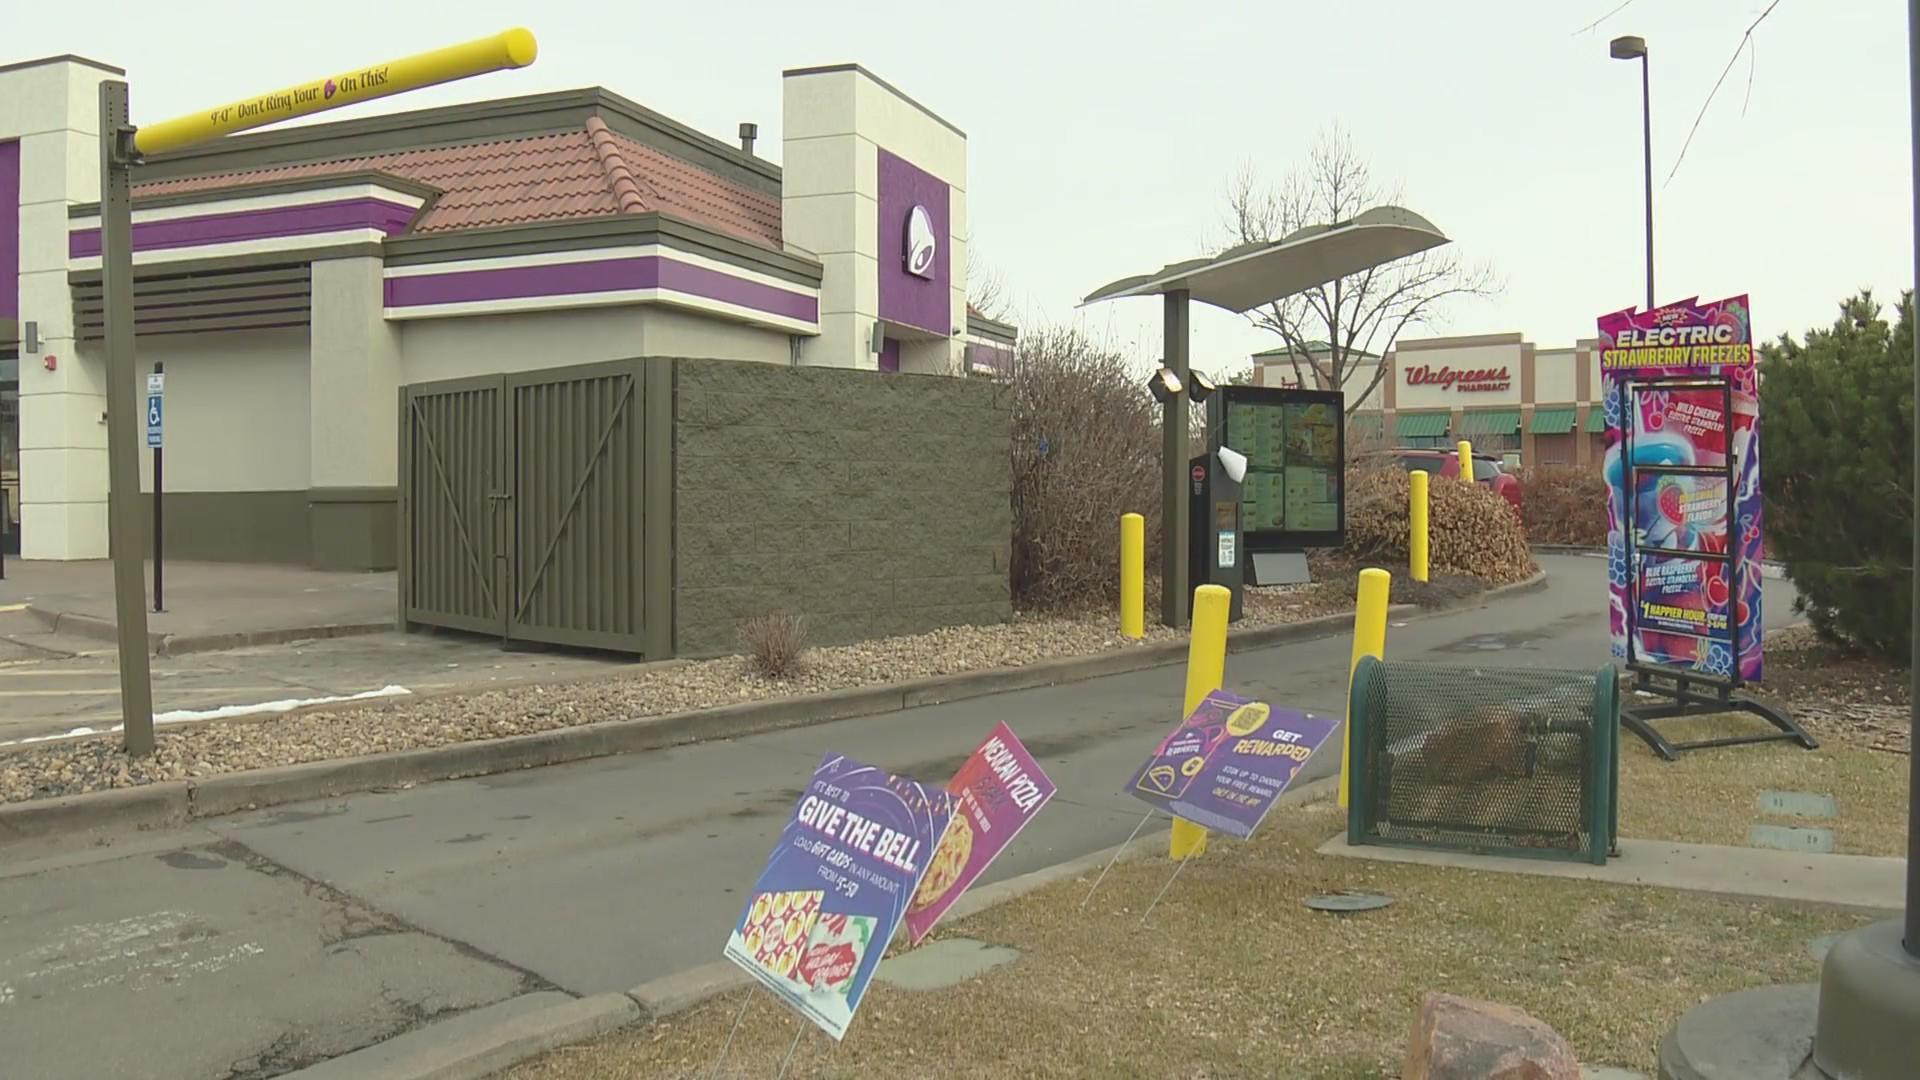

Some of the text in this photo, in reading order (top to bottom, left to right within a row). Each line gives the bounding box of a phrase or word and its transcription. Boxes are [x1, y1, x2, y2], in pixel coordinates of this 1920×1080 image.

[238, 100, 265, 119] Don't
[294, 87, 320, 105] Your
[340, 77, 357, 93] On
[360, 67, 389, 88] This!
[1616, 324, 1733, 348] ELECTRIC
[1603, 344, 1751, 368] STRAWBERRY FREEZES
[1405, 365, 1511, 391] Walgreens
[1457, 382, 1511, 392] PHARMACY
[1650, 604, 1682, 619] HAPPIER
[1272, 729, 1303, 743] GET
[1233, 739, 1313, 762] REWARDED
[978, 736, 1022, 783] MEXICAN
[1006, 773, 1043, 814] PIZZA
[813, 780, 827, 793] IT'S
[824, 784, 842, 799] BEST
[798, 795, 846, 836] GIVE
[839, 811, 881, 852] THE
[793, 835, 813, 851] LOAD
[811, 840, 831, 858] GIFT
[826, 849, 853, 869] CARDS
[867, 873, 900, 895] AMOUNT
[817, 865, 840, 884] FROM
